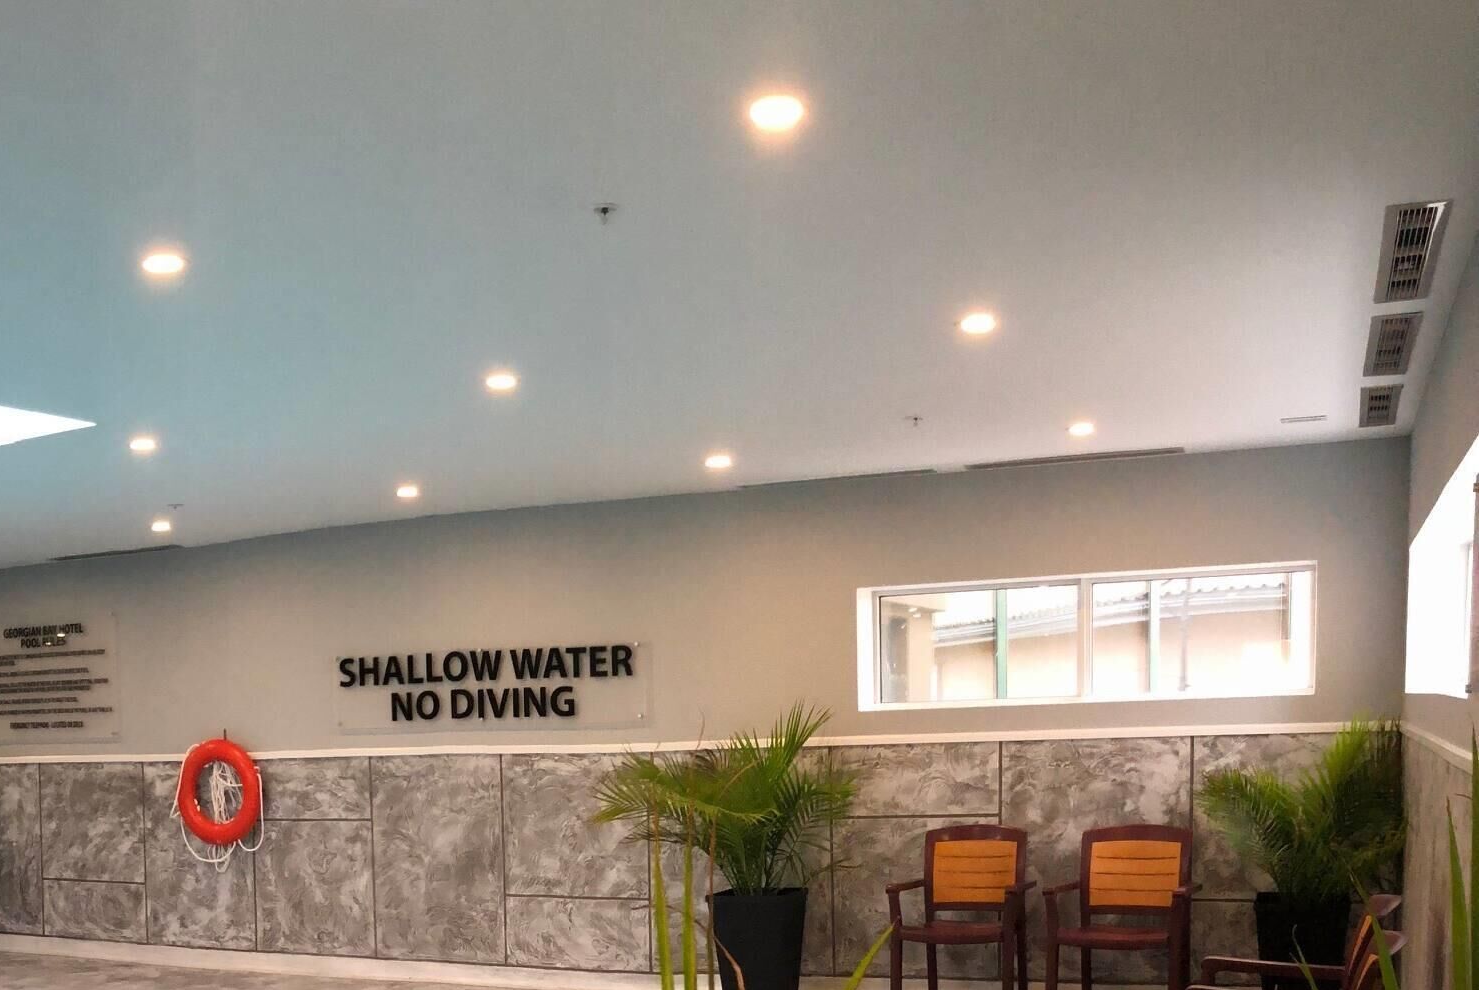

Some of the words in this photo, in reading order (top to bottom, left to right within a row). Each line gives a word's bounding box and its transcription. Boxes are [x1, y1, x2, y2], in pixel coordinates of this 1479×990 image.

[3, 626, 42, 639] GEORGIAN
[42, 624, 58, 636] BAY
[59, 623, 83, 635] HOTEL
[21, 638, 41, 649] POOL
[339, 651, 502, 687] SHALLOW
[510, 645, 633, 679] WATER
[391, 690, 440, 721] NO
[451, 686, 575, 719] DIVING
